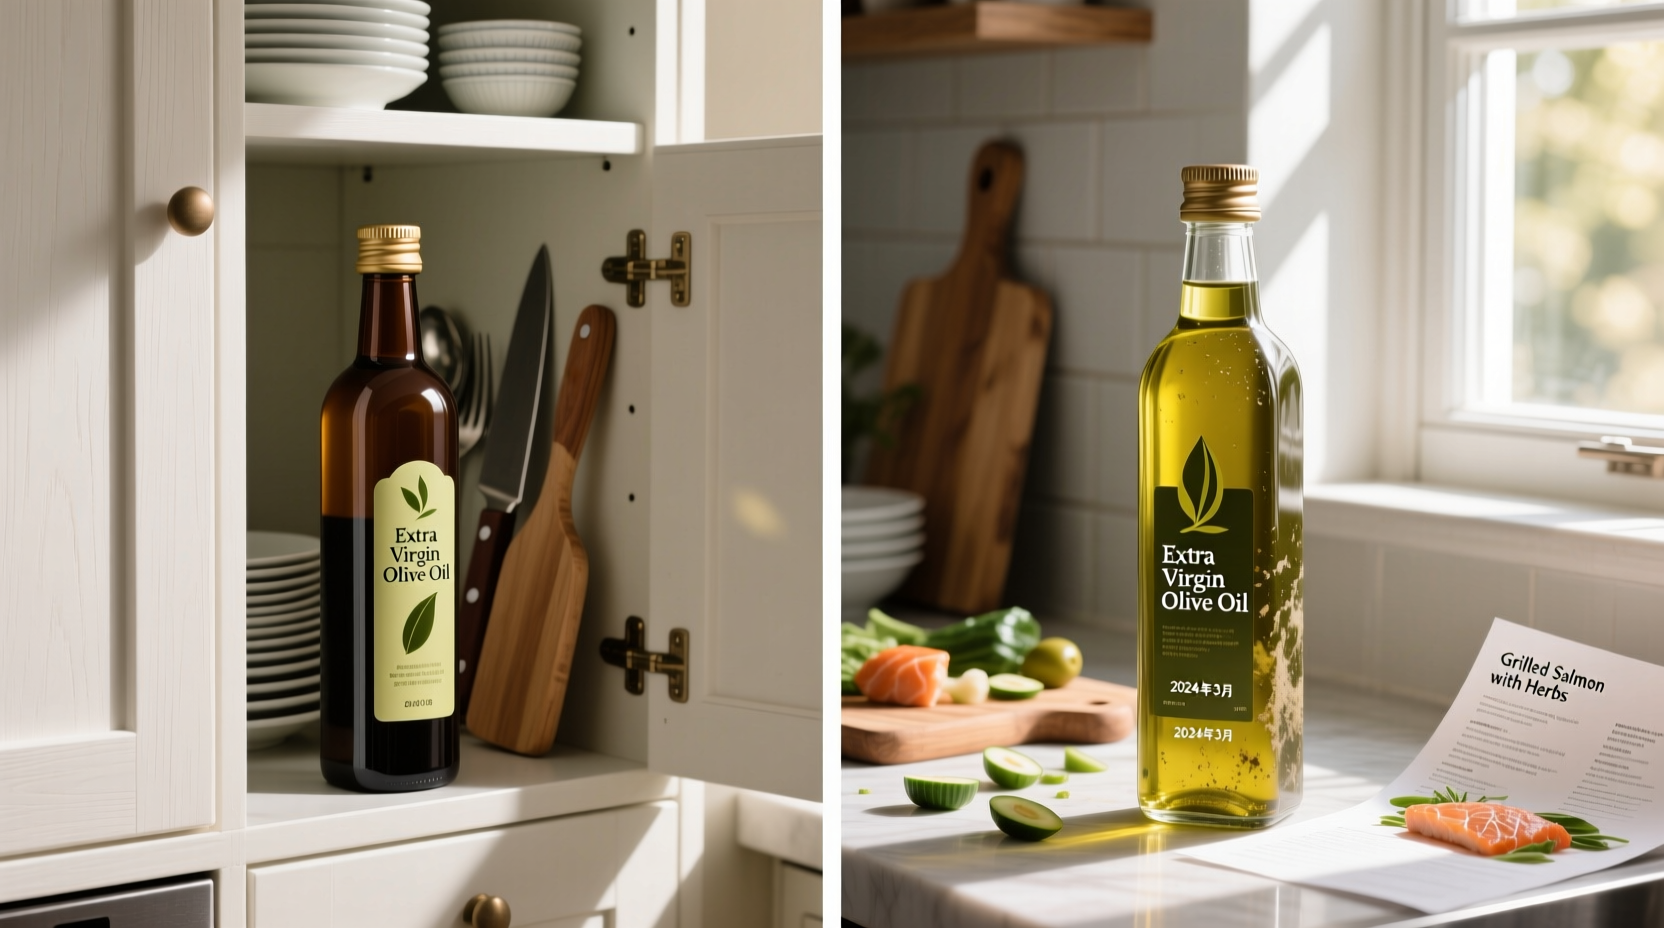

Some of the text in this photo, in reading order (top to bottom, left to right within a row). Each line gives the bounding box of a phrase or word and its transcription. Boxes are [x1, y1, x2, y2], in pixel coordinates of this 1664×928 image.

[395, 527, 437, 543] Extra
[390, 546, 440, 567] Virgin
[1162, 544, 1215, 565] Extra
[383, 563, 450, 583] Olive Oil
[1161, 568, 1225, 593] Virgin
[1161, 591, 1249, 612] Olive Oil
[1501, 652, 1605, 693] Grilled Salmon
[1170, 679, 1232, 698] 2024年3月
[1491, 672, 1569, 702] with Herbs
[1173, 726, 1232, 742] 2024年3月
